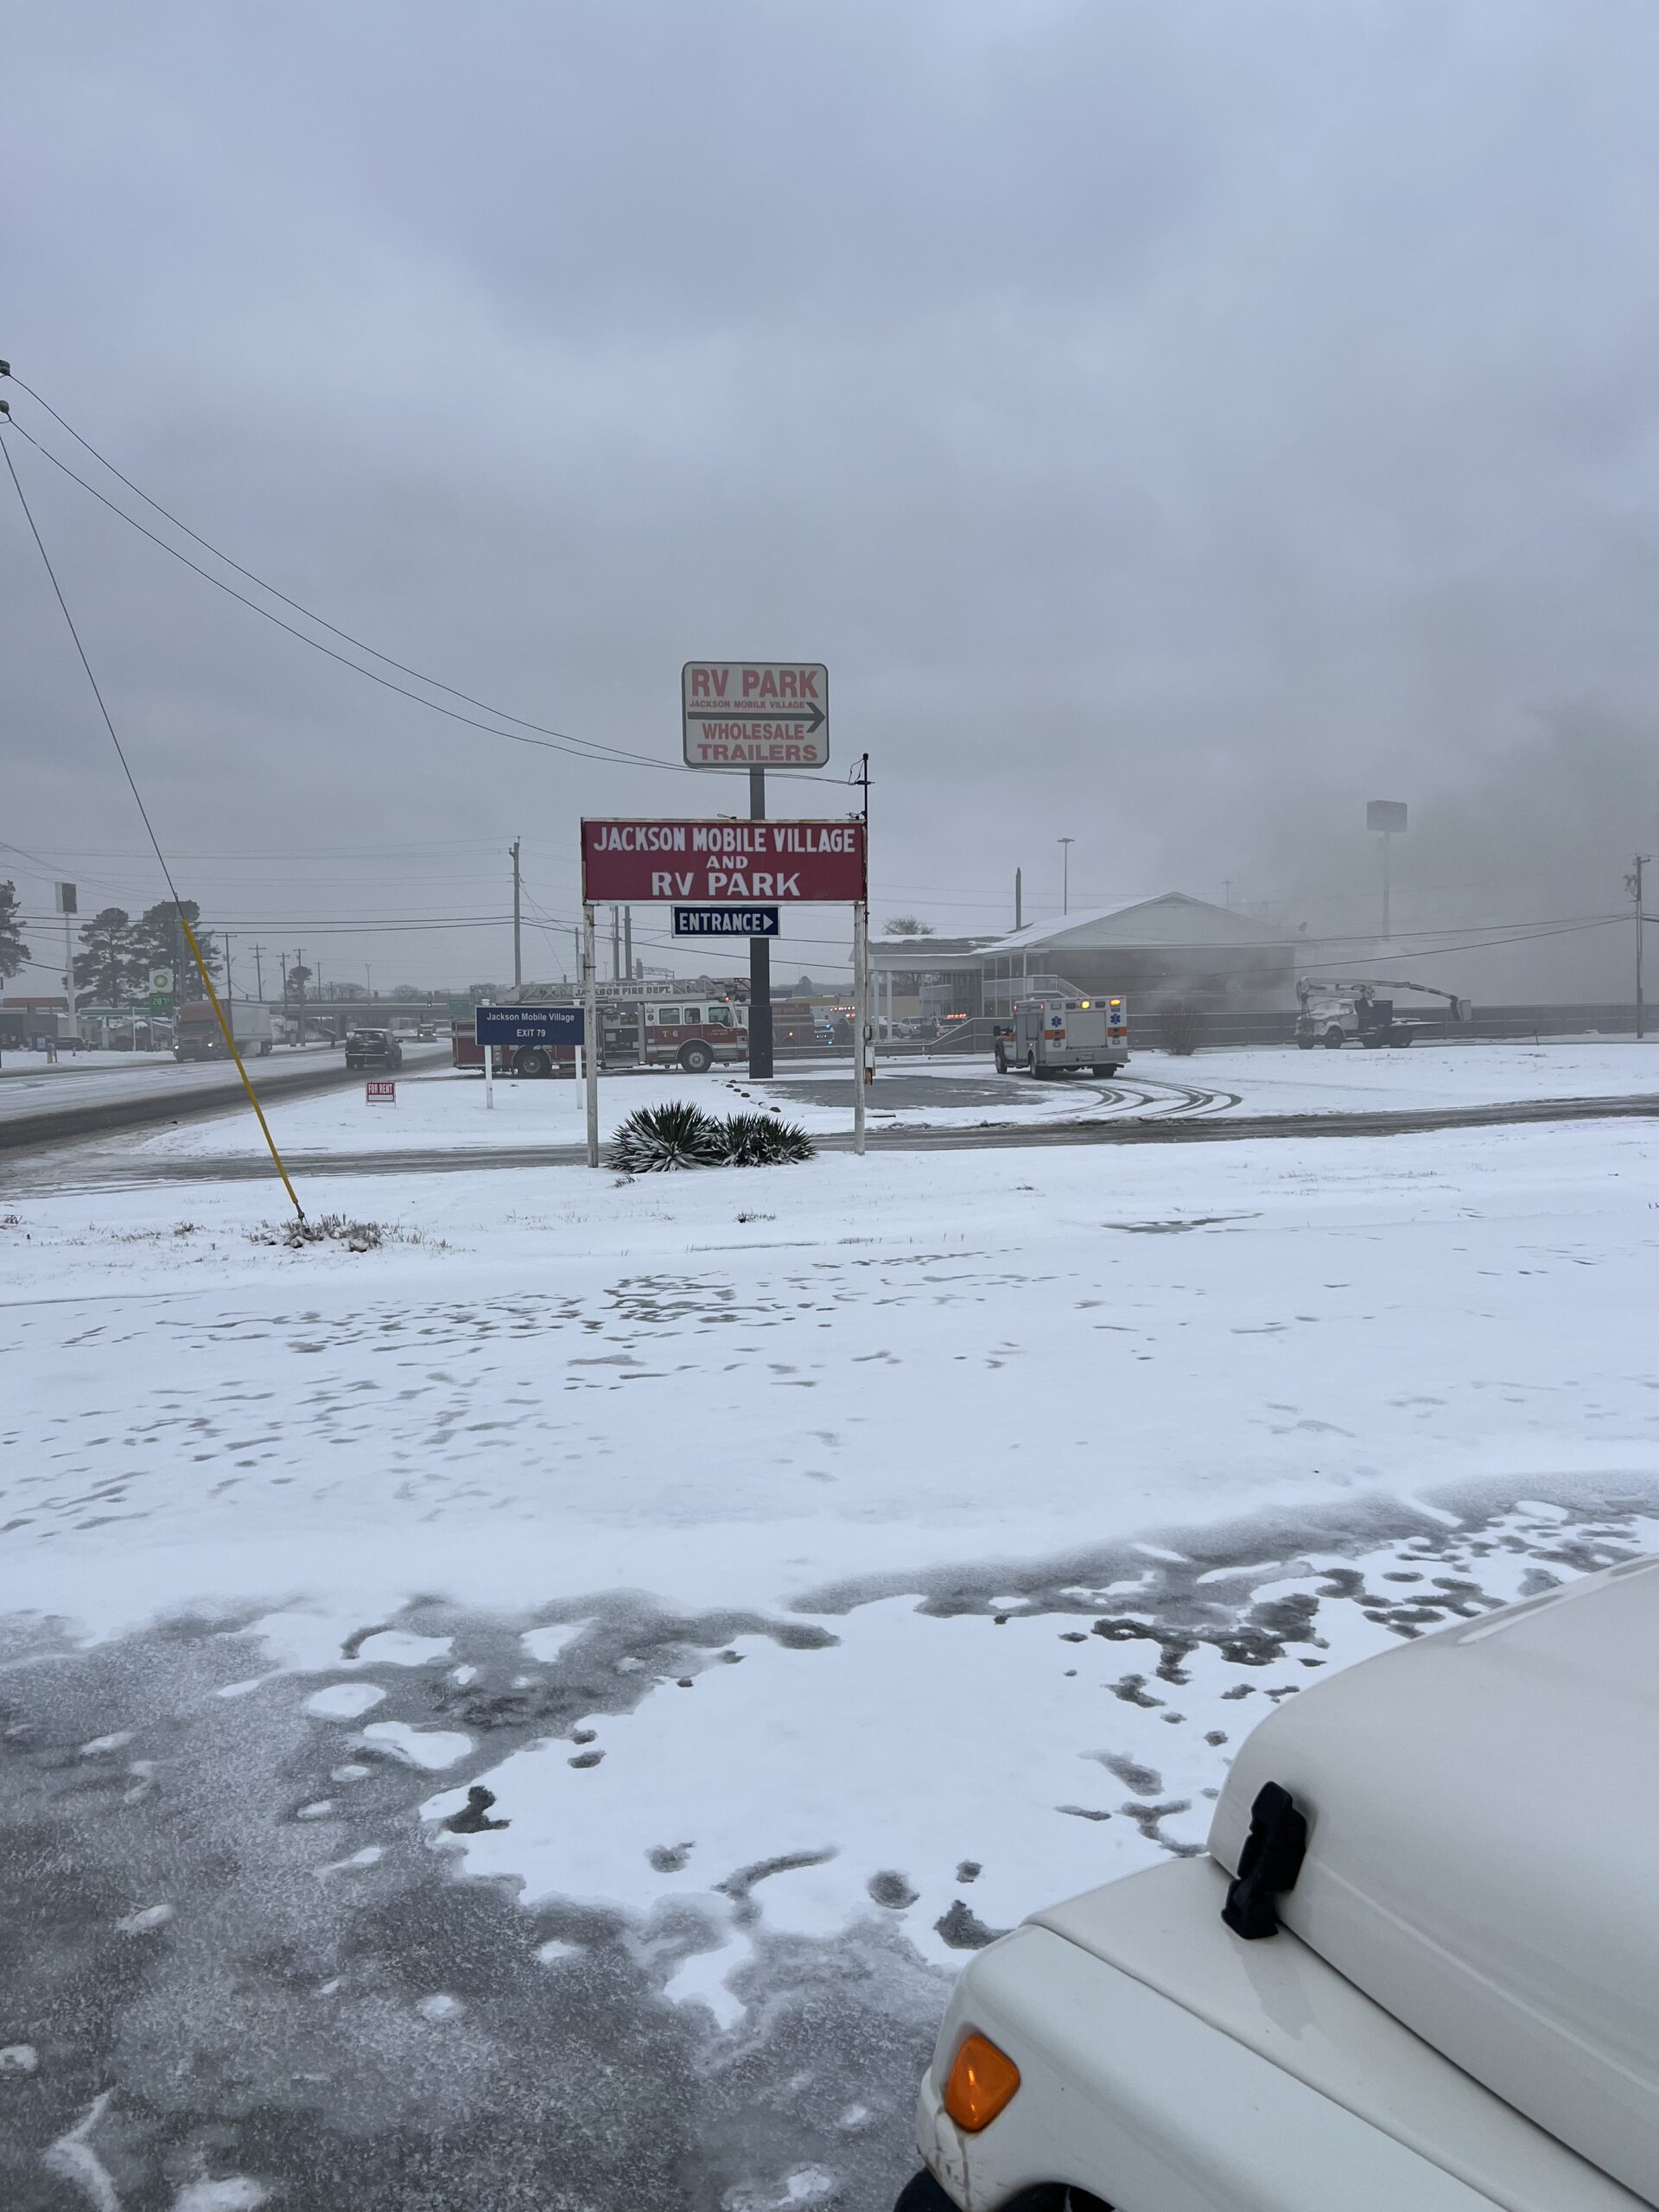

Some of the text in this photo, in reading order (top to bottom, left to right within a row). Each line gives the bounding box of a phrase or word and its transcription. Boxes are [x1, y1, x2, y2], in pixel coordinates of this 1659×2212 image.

[691, 669, 819, 698] RV PARK
[702, 722, 804, 741] WHOLESALE
[697, 744, 817, 761] TRAILERS
[594, 826, 855, 853] JACKSON MOBILE VILLAGE
[706, 855, 748, 869] AND
[652, 871, 801, 897] RV PARK
[678, 912, 761, 931] ENTRANCE
[575, 985, 671, 997] JAKSON FIRE DEPT.
[486, 1013, 575, 1023] Jackson Mobile Village
[368, 1084, 392, 1093] FOR RENT
